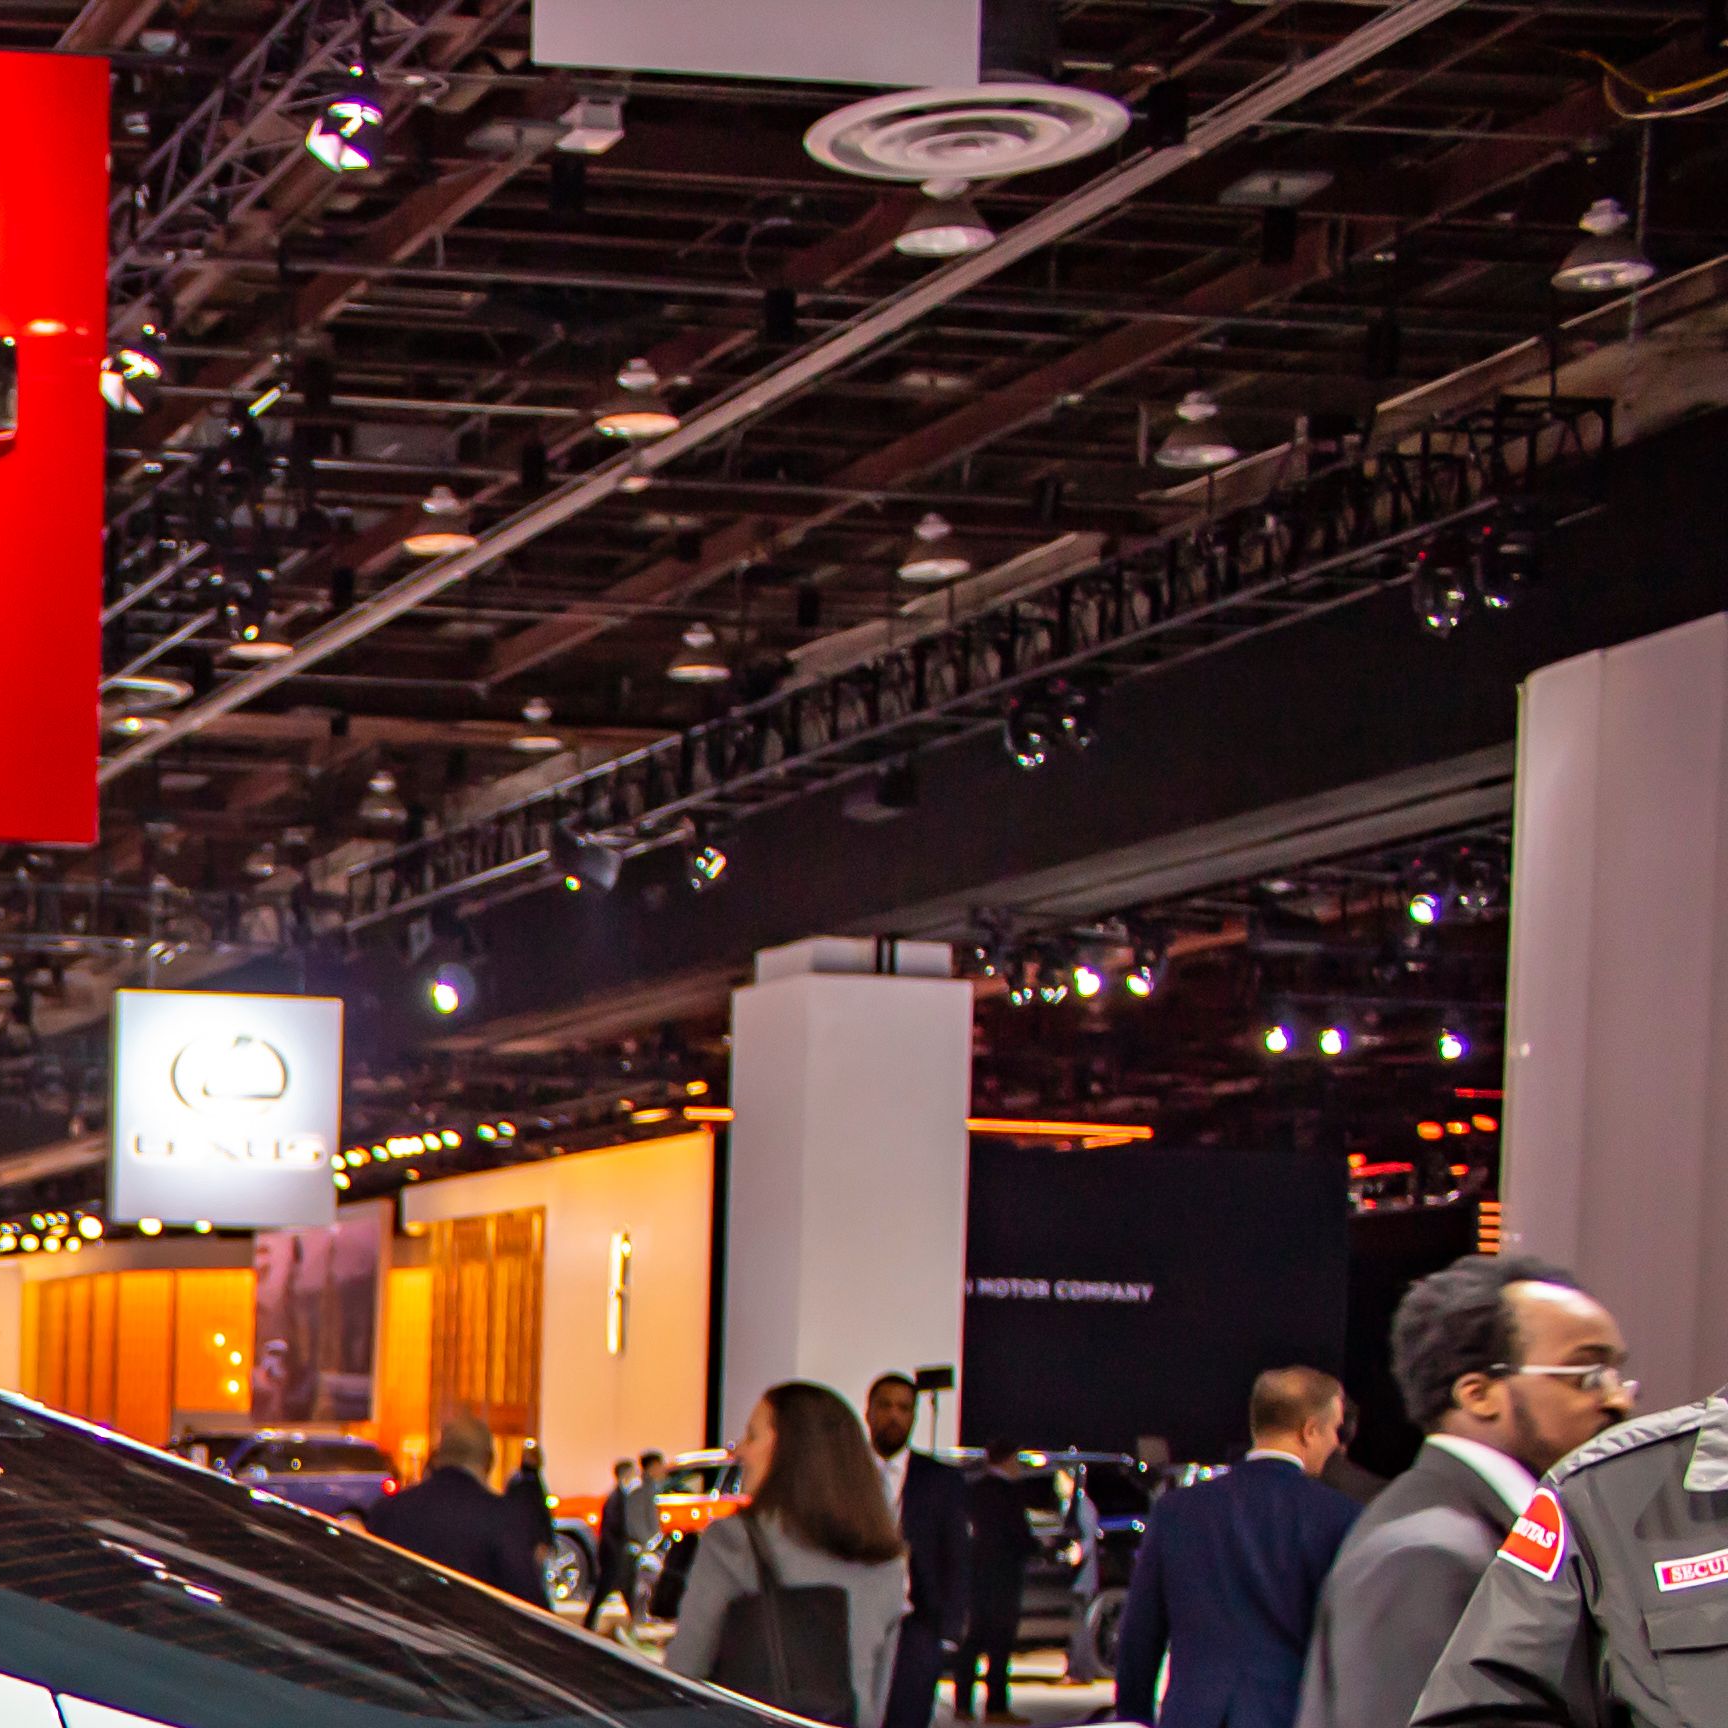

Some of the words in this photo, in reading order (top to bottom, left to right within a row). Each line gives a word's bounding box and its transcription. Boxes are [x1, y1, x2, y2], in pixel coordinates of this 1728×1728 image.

[976, 1277, 1050, 1299] MOTOR
[1053, 1279, 1155, 1304] COMPANY
[1671, 1556, 1728, 1583] SECU
